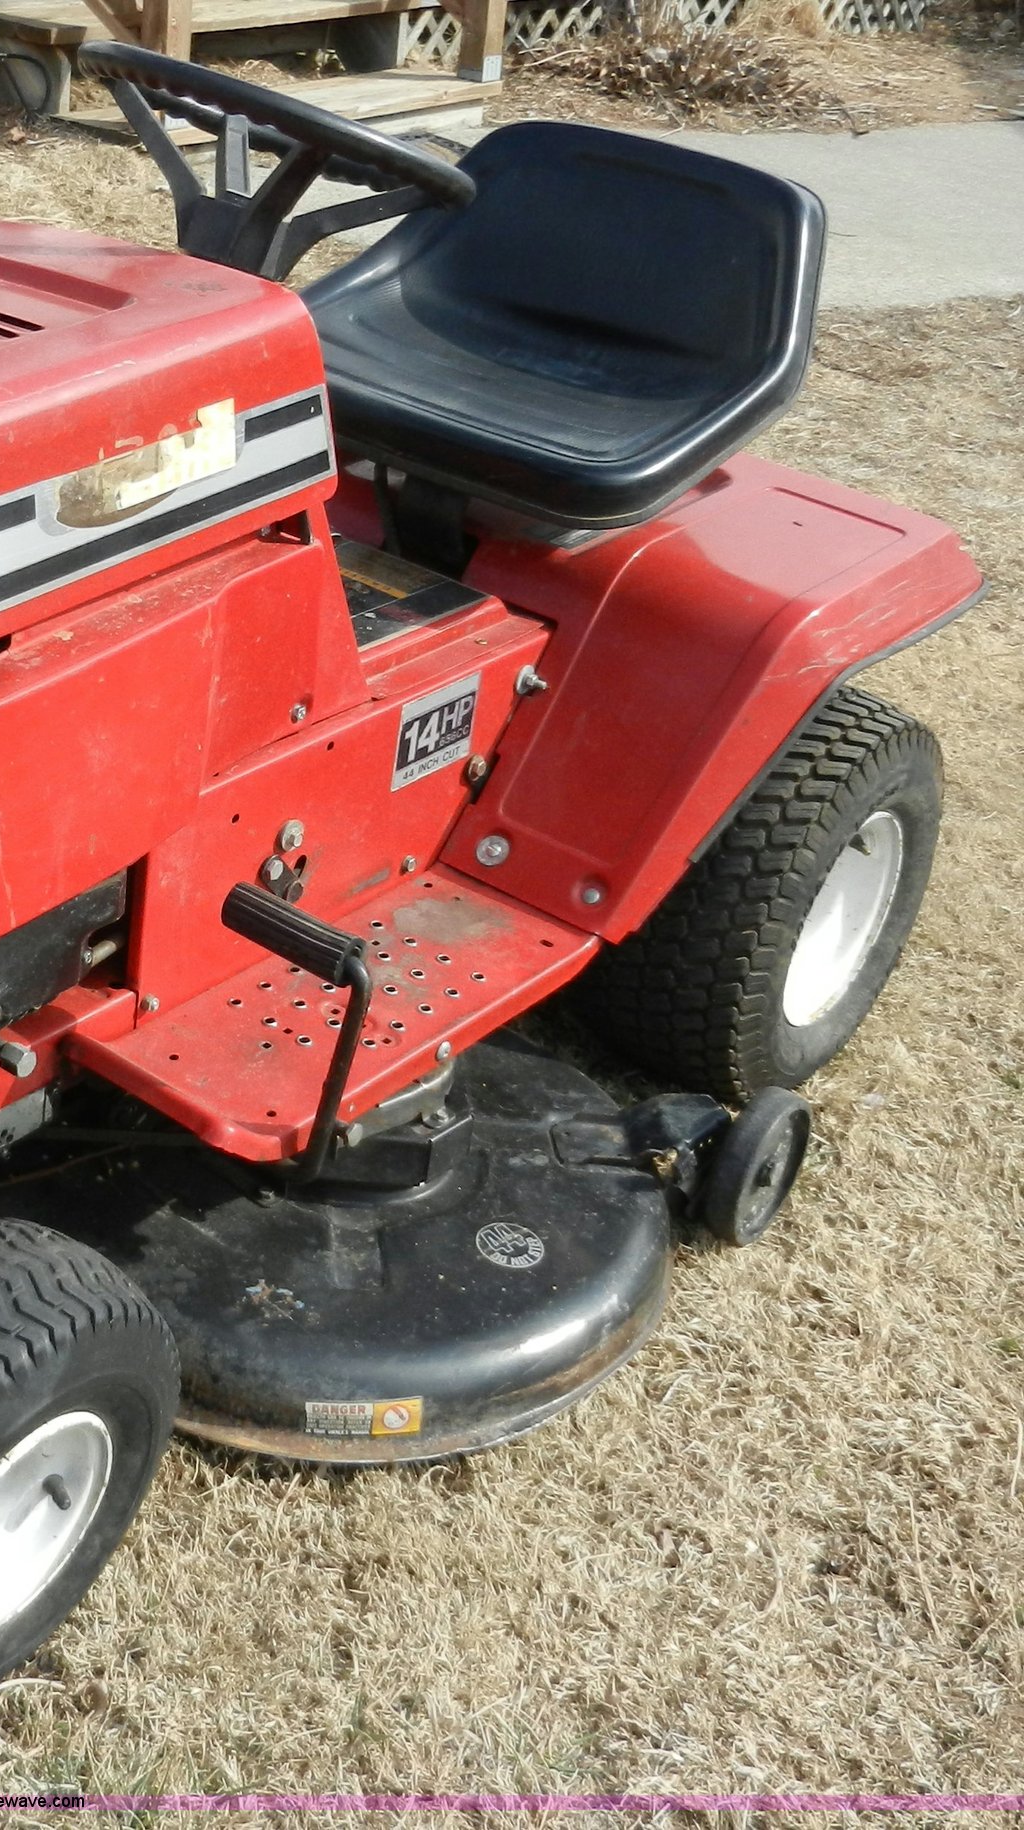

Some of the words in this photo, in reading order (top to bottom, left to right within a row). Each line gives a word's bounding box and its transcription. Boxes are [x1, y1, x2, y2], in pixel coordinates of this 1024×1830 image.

[403, 768, 415, 780] 44
[417, 757, 439, 773] INCH
[442, 745, 461, 762] CUT
[490, 1252, 508, 1265] DO
[511, 1253, 534, 1266] NOT
[525, 1237, 542, 1257] STEP
[311, 1404, 367, 1416] DANGER
